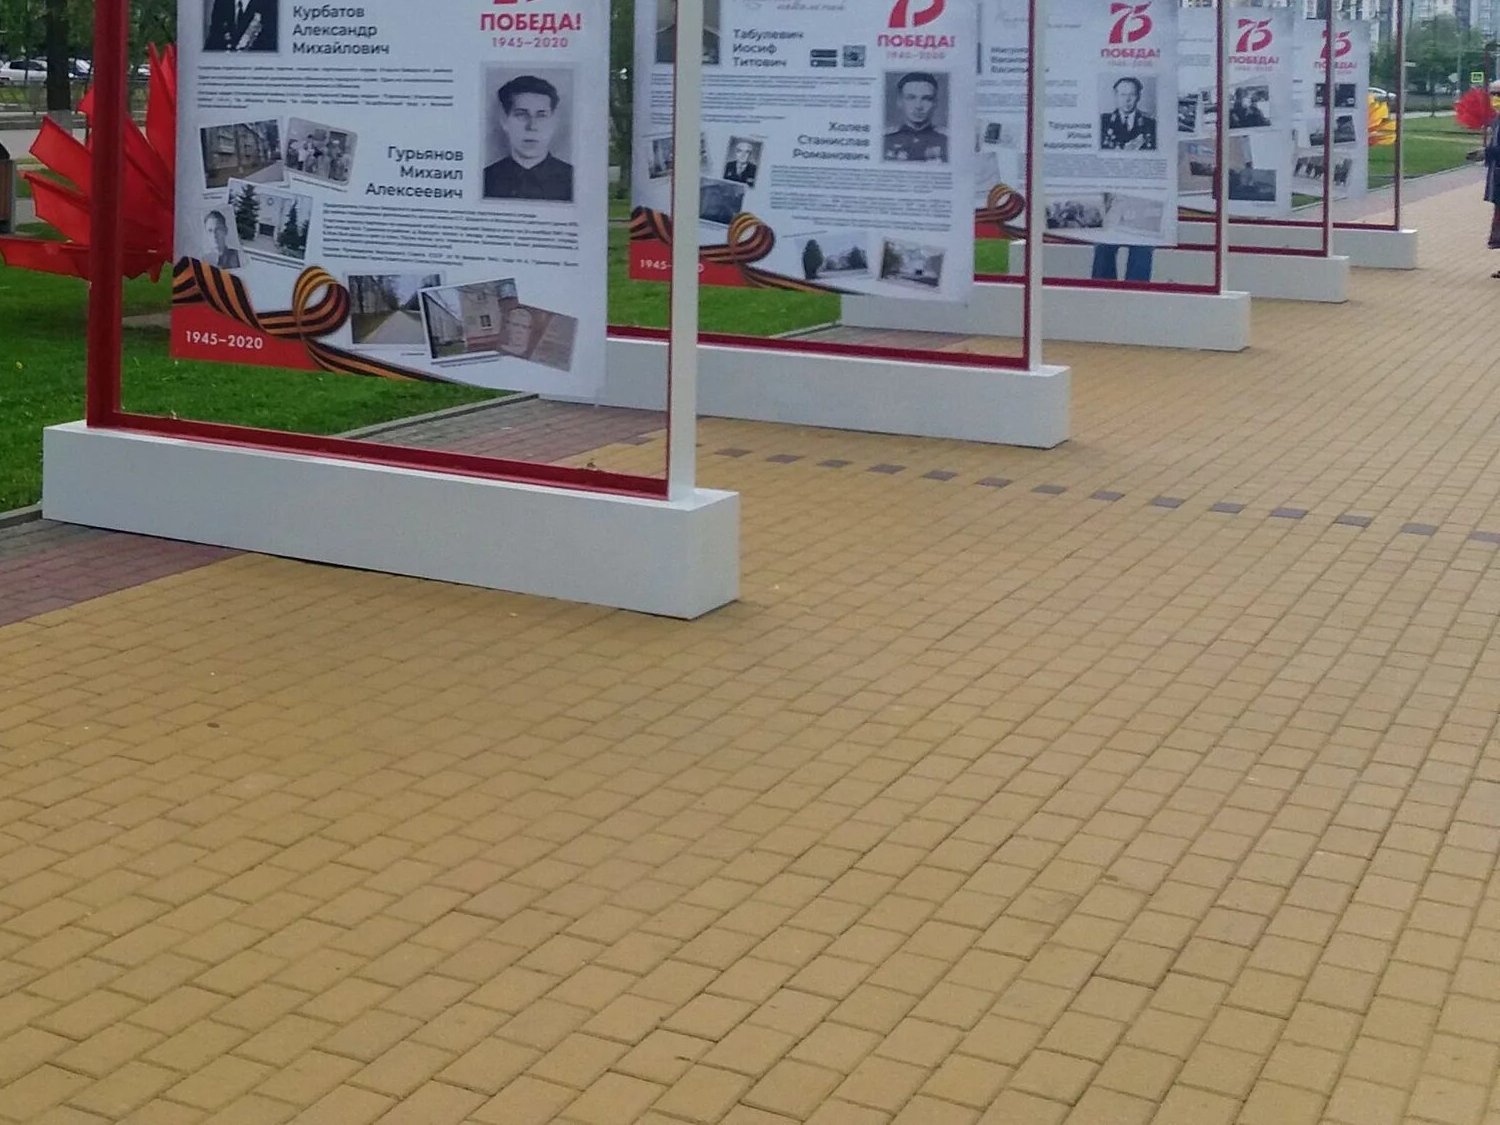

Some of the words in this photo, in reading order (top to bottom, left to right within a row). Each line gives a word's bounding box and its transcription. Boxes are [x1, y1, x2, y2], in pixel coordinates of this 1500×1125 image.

[293, 4, 365, 21] Курбатов
[292, 23, 378, 38] Александр
[480, 13, 581, 35] ПОБЕДА!
[292, 41, 390, 55] Михайлович
[388, 146, 464, 163] Гурьянов
[400, 165, 463, 180] Михаил
[365, 182, 463, 199] Алексеевич
